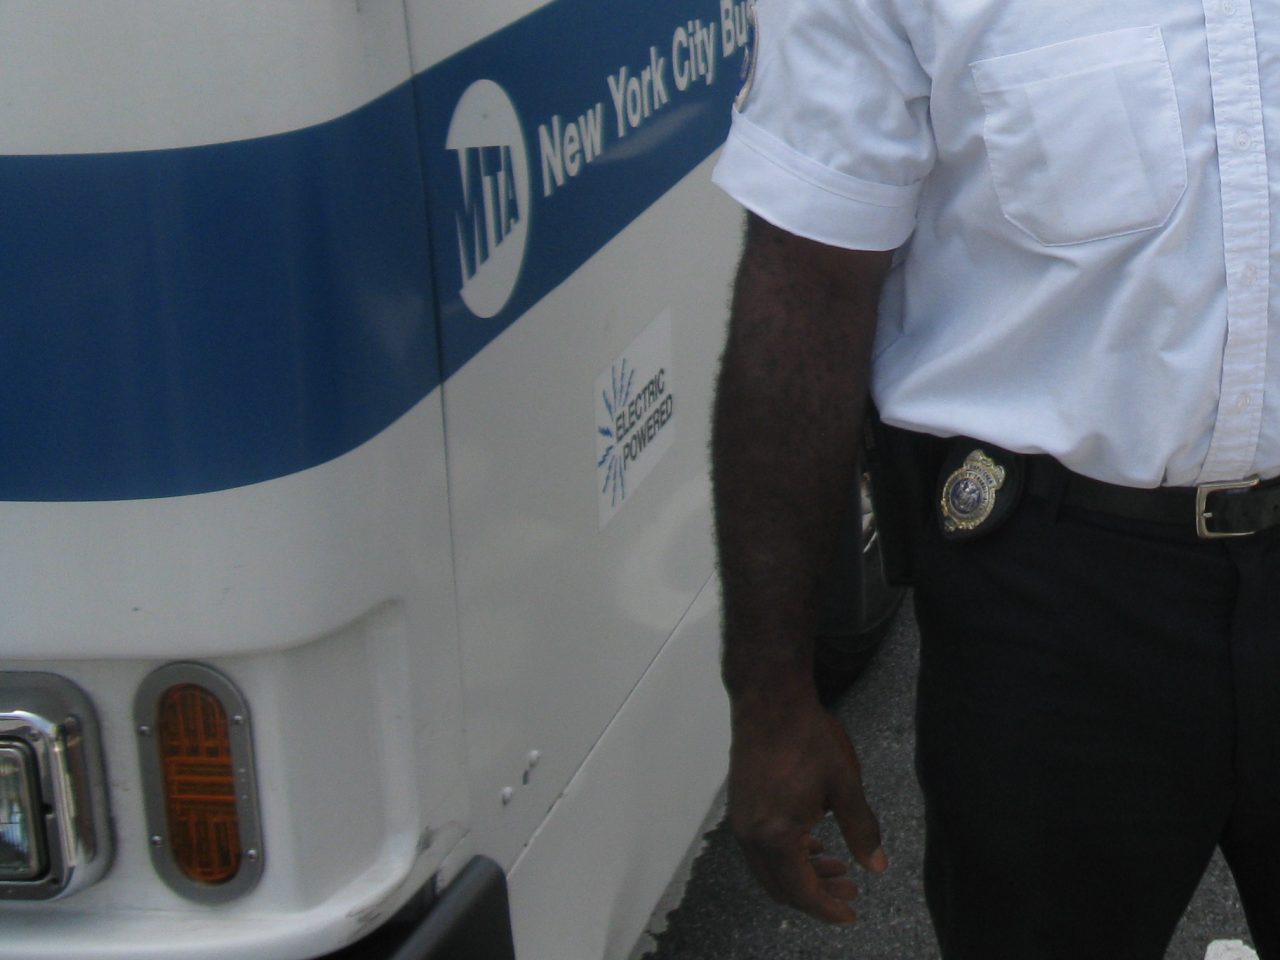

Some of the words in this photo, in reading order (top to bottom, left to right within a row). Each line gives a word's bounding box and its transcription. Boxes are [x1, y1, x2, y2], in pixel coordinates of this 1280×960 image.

[538, 102, 602, 197] New
[607, 45, 669, 138] York
[672, 19, 716, 86] City
[446, 145, 521, 290] MTA
[615, 367, 665, 442] ELECTRIC
[623, 393, 673, 471] POWERED
